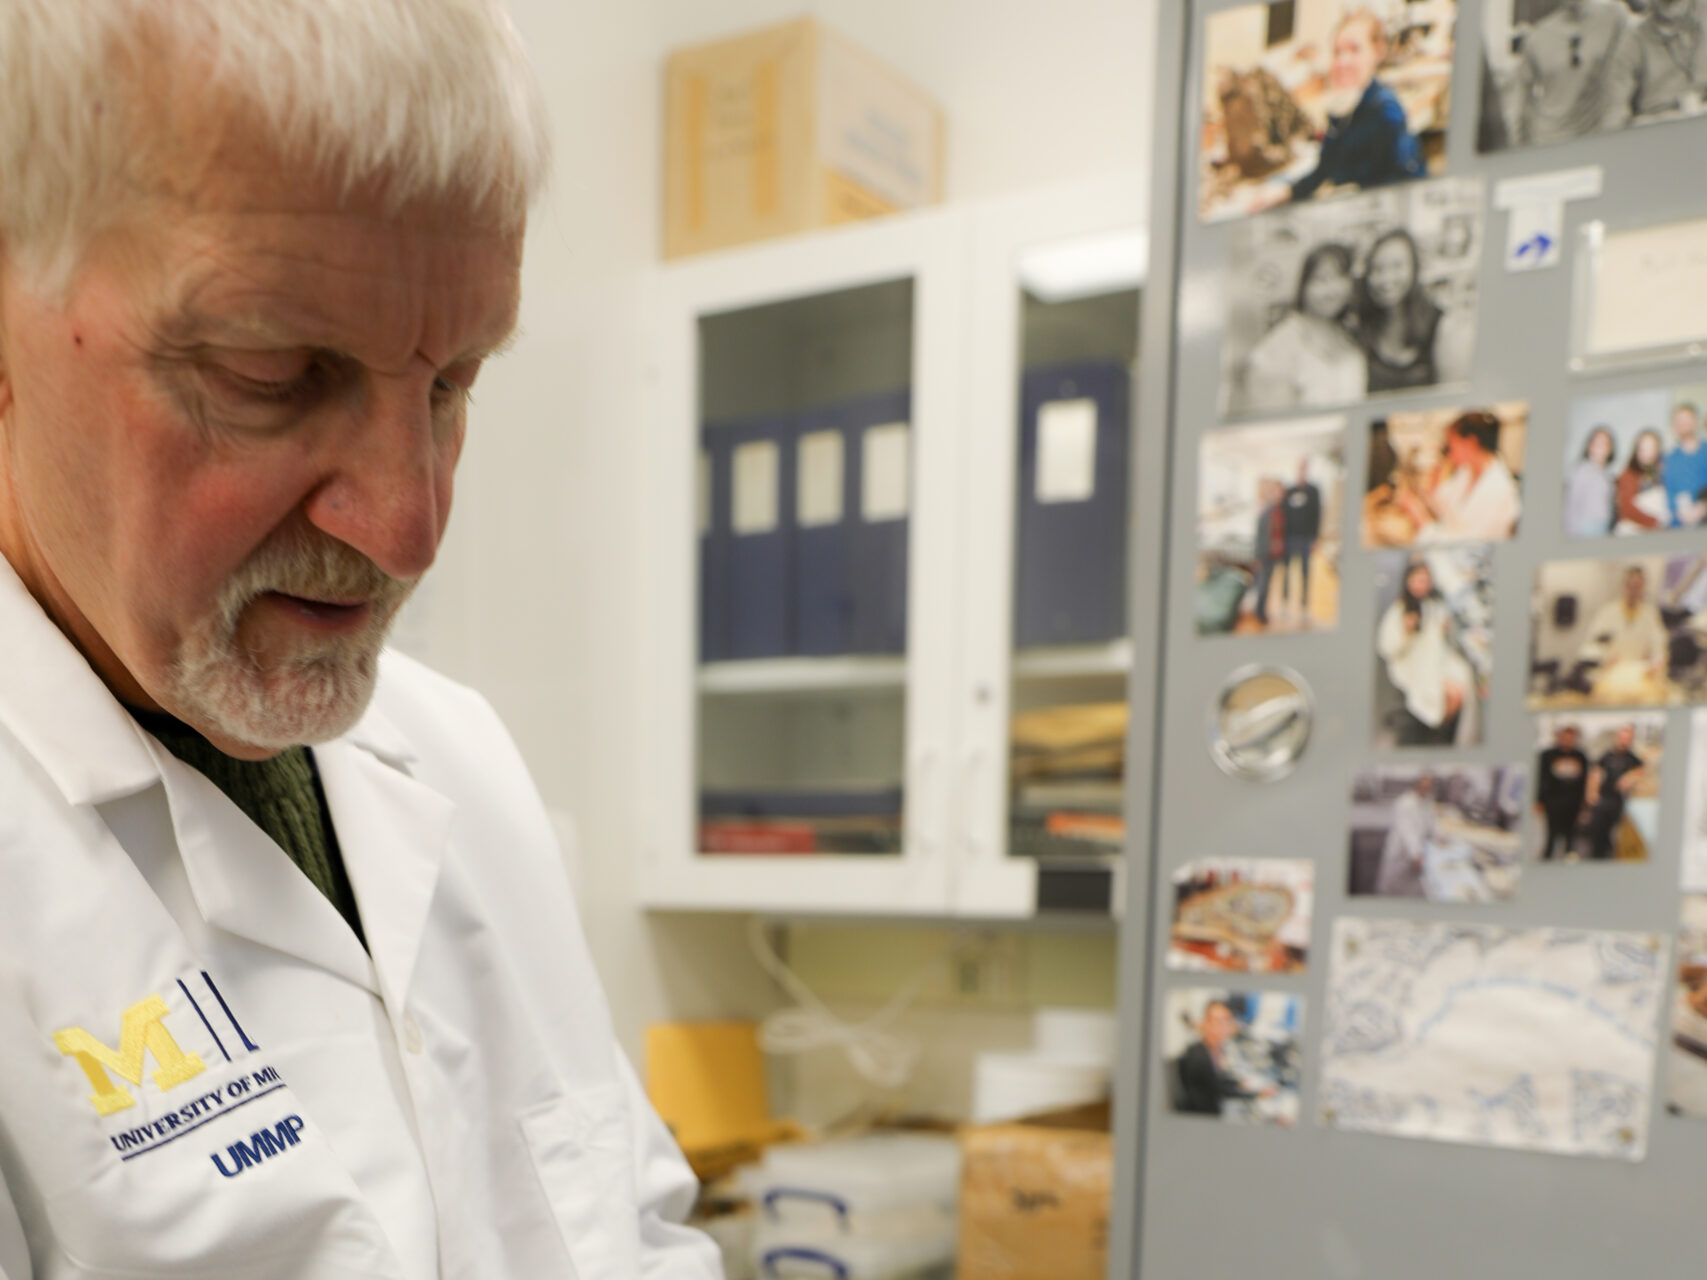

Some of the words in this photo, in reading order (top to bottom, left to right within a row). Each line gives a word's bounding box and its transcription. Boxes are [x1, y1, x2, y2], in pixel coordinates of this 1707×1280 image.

[53, 993, 207, 1117] M
[110, 1088, 224, 1152] UNIVERSITY
[227, 1075, 252, 1098] OF
[210, 1114, 305, 1178] UMMP
